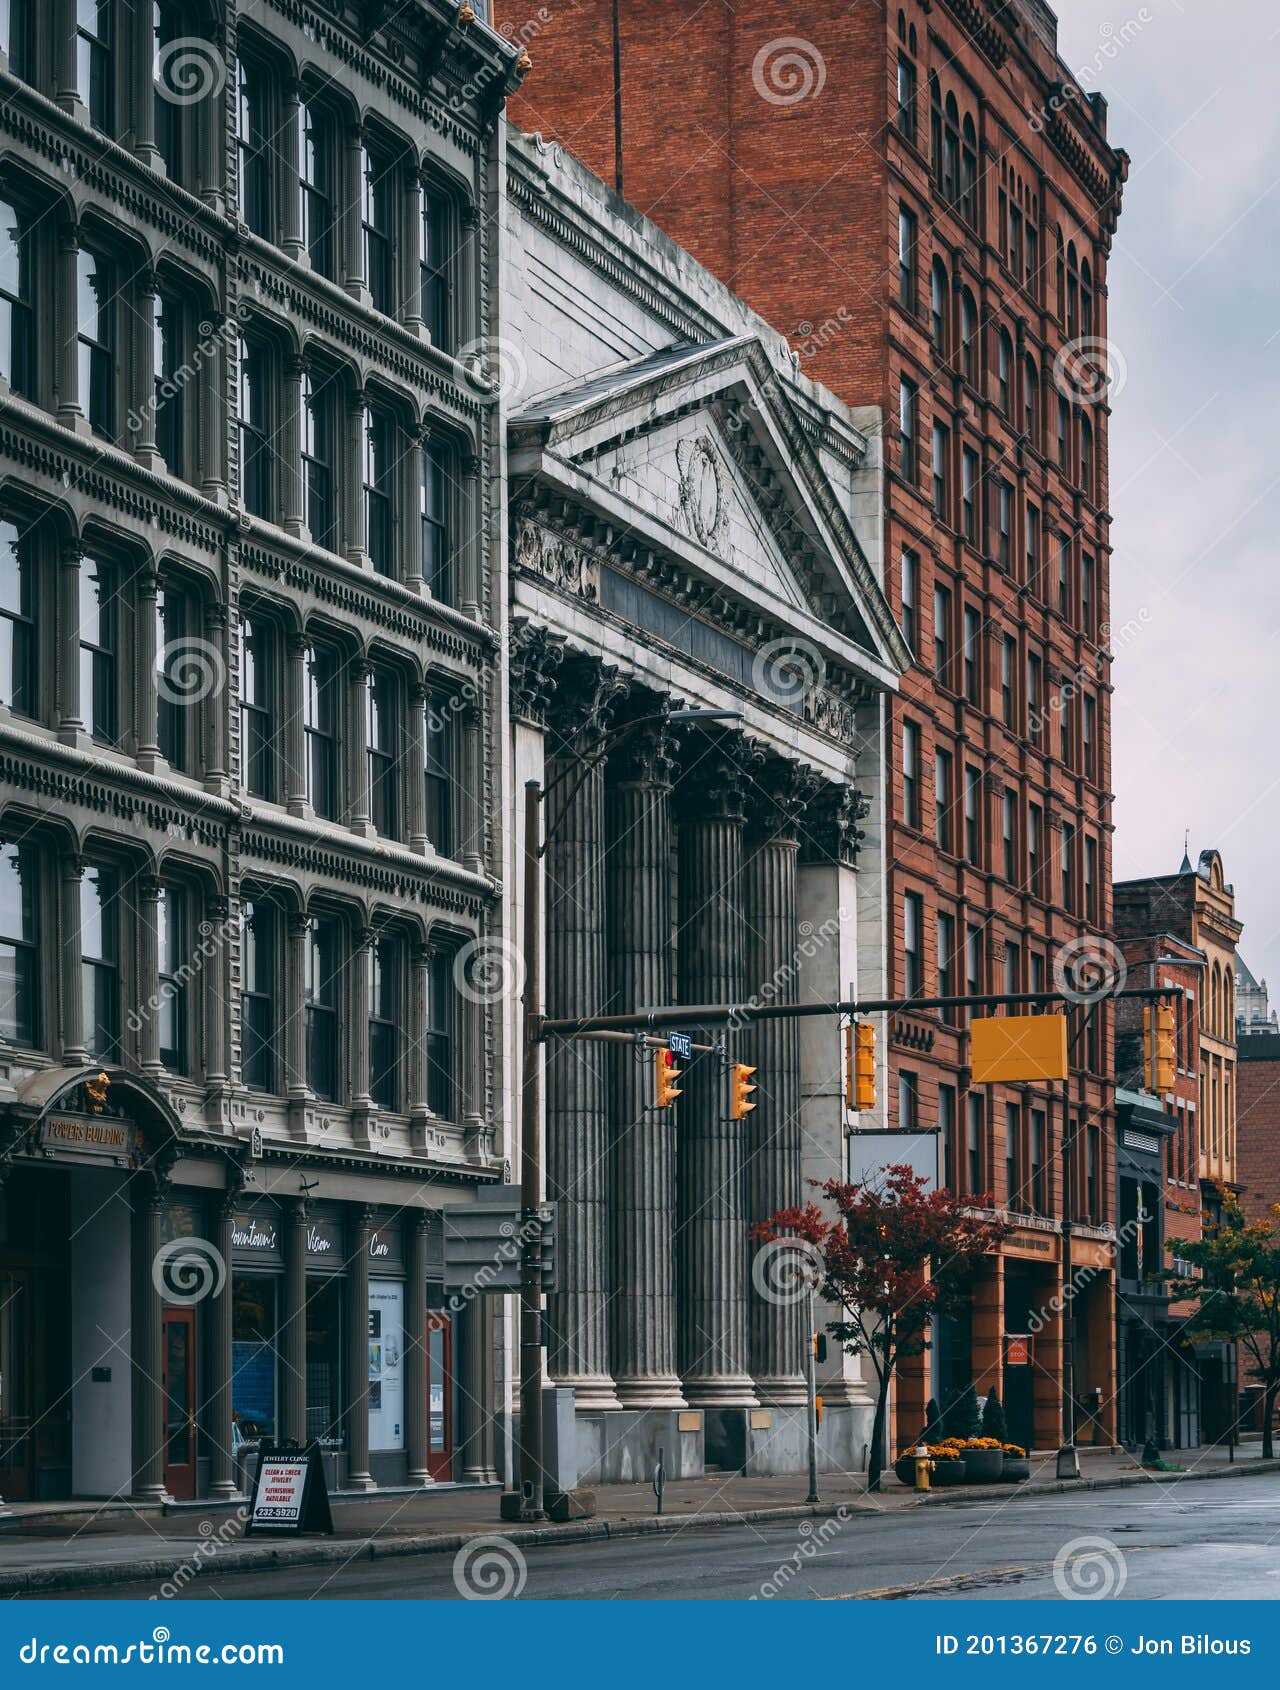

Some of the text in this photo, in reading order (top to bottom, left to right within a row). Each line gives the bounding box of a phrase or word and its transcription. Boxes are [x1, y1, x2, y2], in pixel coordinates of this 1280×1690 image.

[671, 1035, 689, 1055] STATE
[49, 1121, 125, 1145] POWERS BUILDING
[307, 1226, 331, 1252] Vision
[370, 1233, 388, 1256] Care
[258, 1508, 297, 1517] 232-5920
